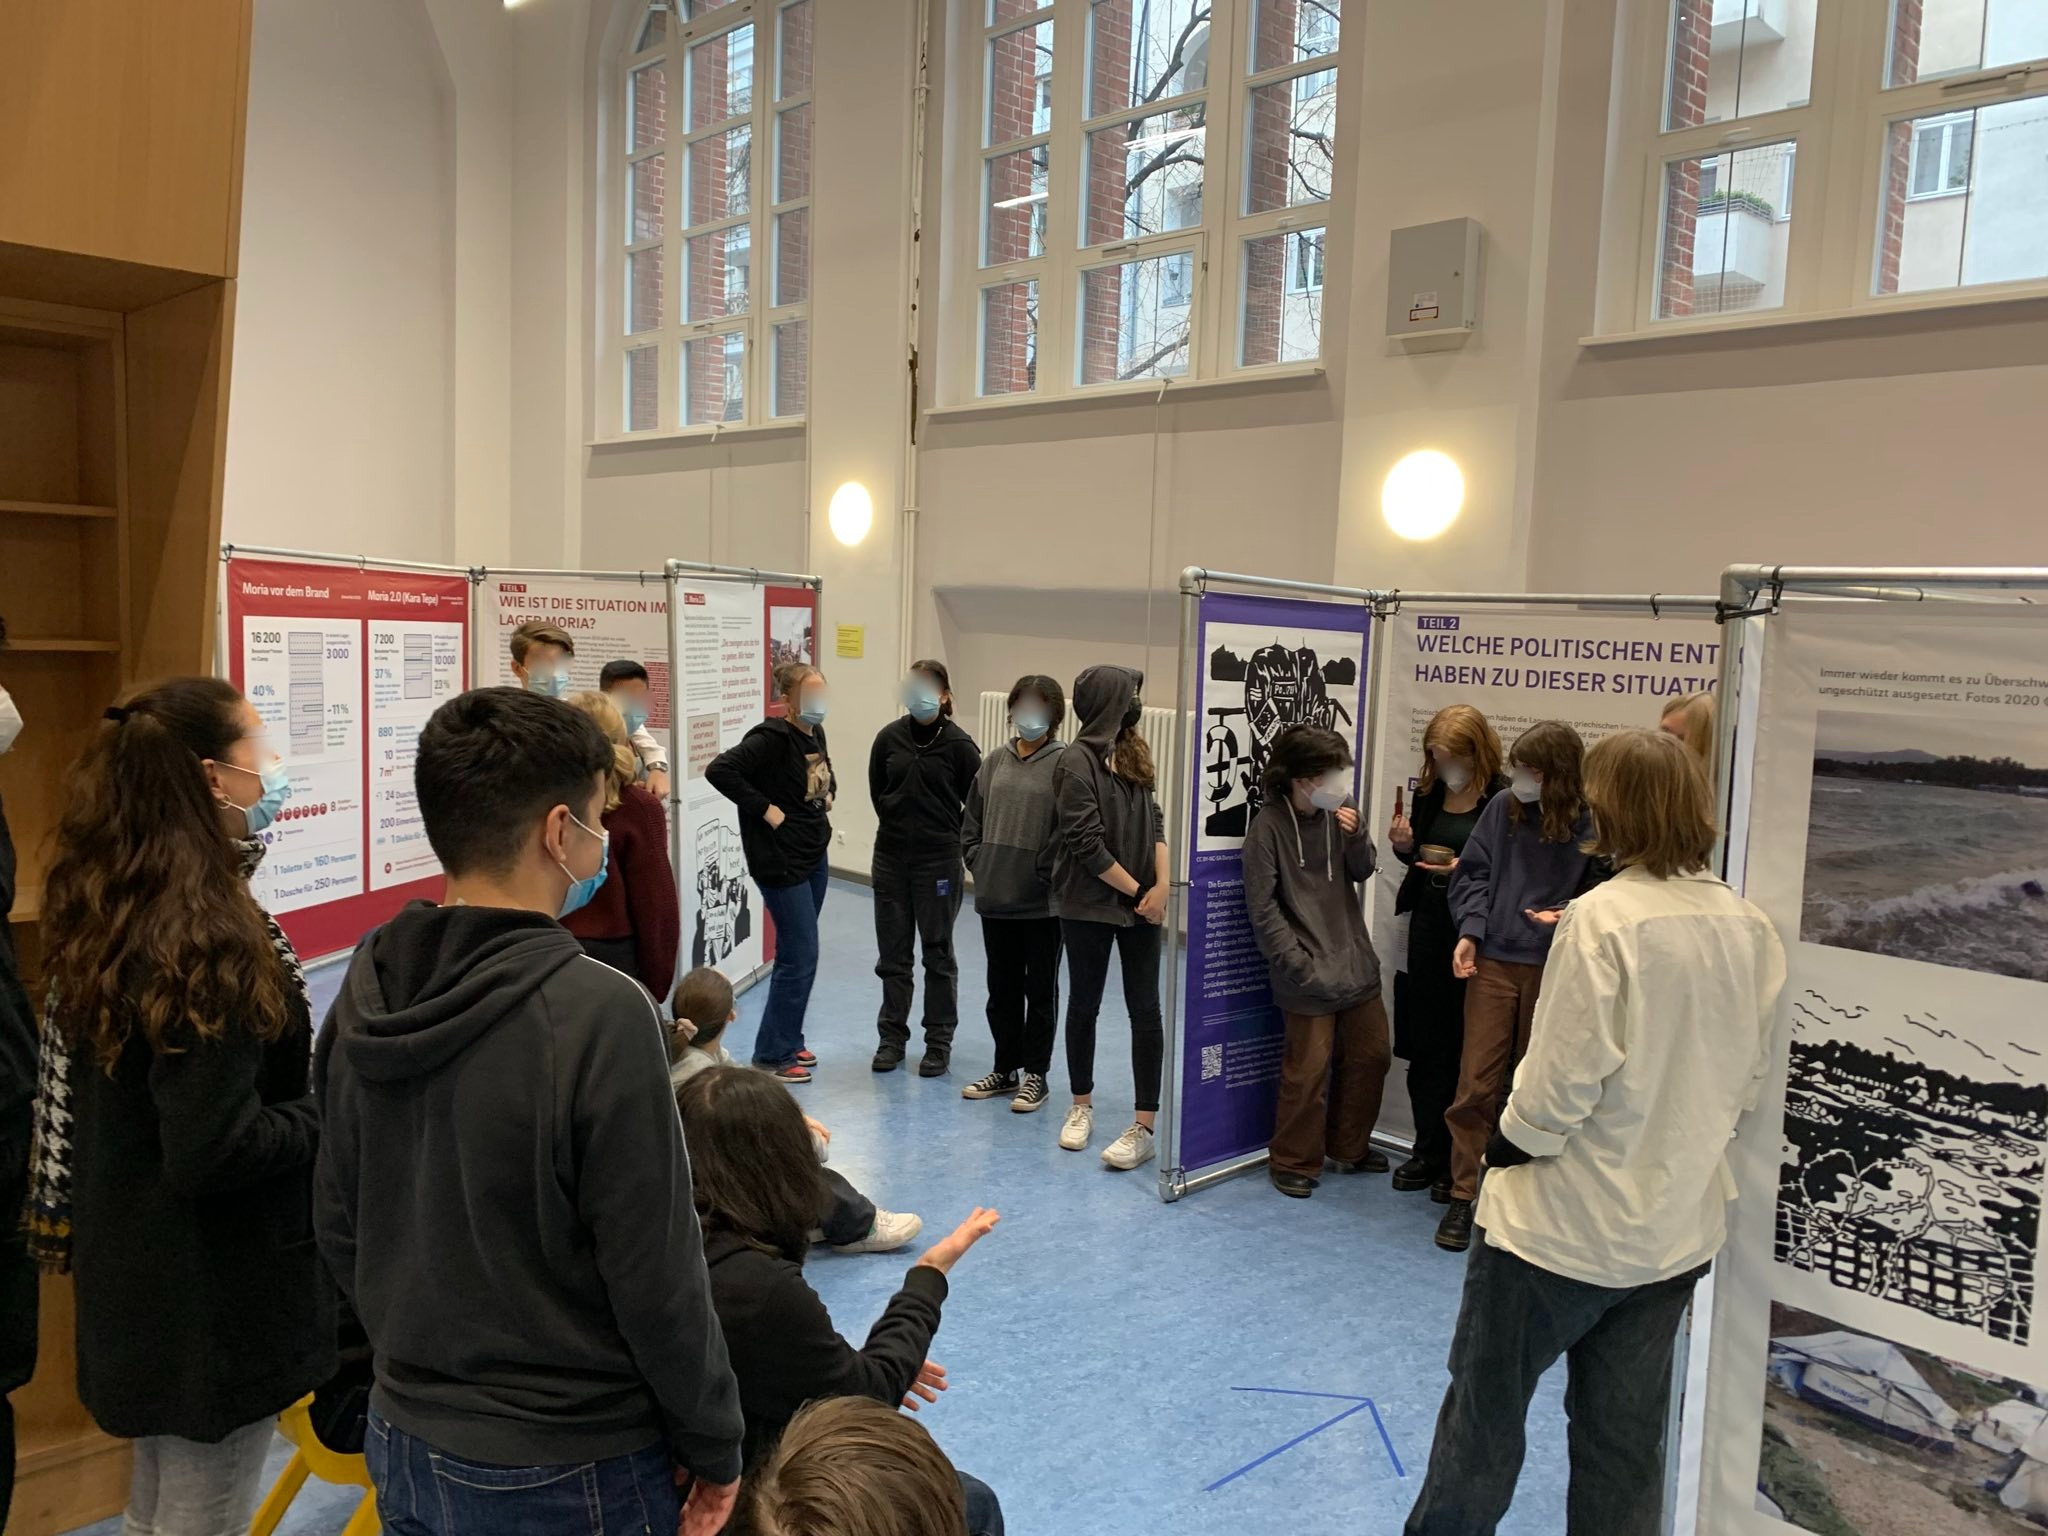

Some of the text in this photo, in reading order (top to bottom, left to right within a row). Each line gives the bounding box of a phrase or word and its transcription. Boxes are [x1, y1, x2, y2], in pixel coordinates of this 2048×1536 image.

[242, 582, 269, 597] Moria
[270, 586, 285, 596] vor
[285, 585, 304, 597] dem
[305, 586, 329, 598] Brand
[368, 590, 388, 602] Moria
[389, 592, 401, 602] 2.0
[500, 596, 667, 614] WIE IST DIE SITUATION IM
[1421, 617, 1457, 629] TEIL 2
[1417, 634, 1720, 665] WELCHE POLITISCHEN ENT
[1415, 664, 1486, 685] HABEN
[1492, 668, 1519, 687] ZU
[1525, 672, 1605, 693] DIESER
[1820, 667, 1857, 680] Immer
[1859, 670, 1900, 682] wieder
[1902, 671, 1945, 684] kommt
[1949, 676, 1962, 685] es
[1966, 676, 1981, 686] zu
[1818, 685, 2040, 706] ungeschützt ausgesetzt. Fotos 2020
[1496, 715, 1516, 723] haben
[1574, 720, 1619, 730] griechischen
[280, 863, 303, 875] Toilette
[304, 860, 314, 870] für
[314, 855, 331, 867] 160
[331, 853, 358, 864] Personen
[280, 886, 303, 898] Dusche
[304, 883, 314, 893] für
[315, 877, 331, 890] 250
[332, 875, 358, 886] Personen
